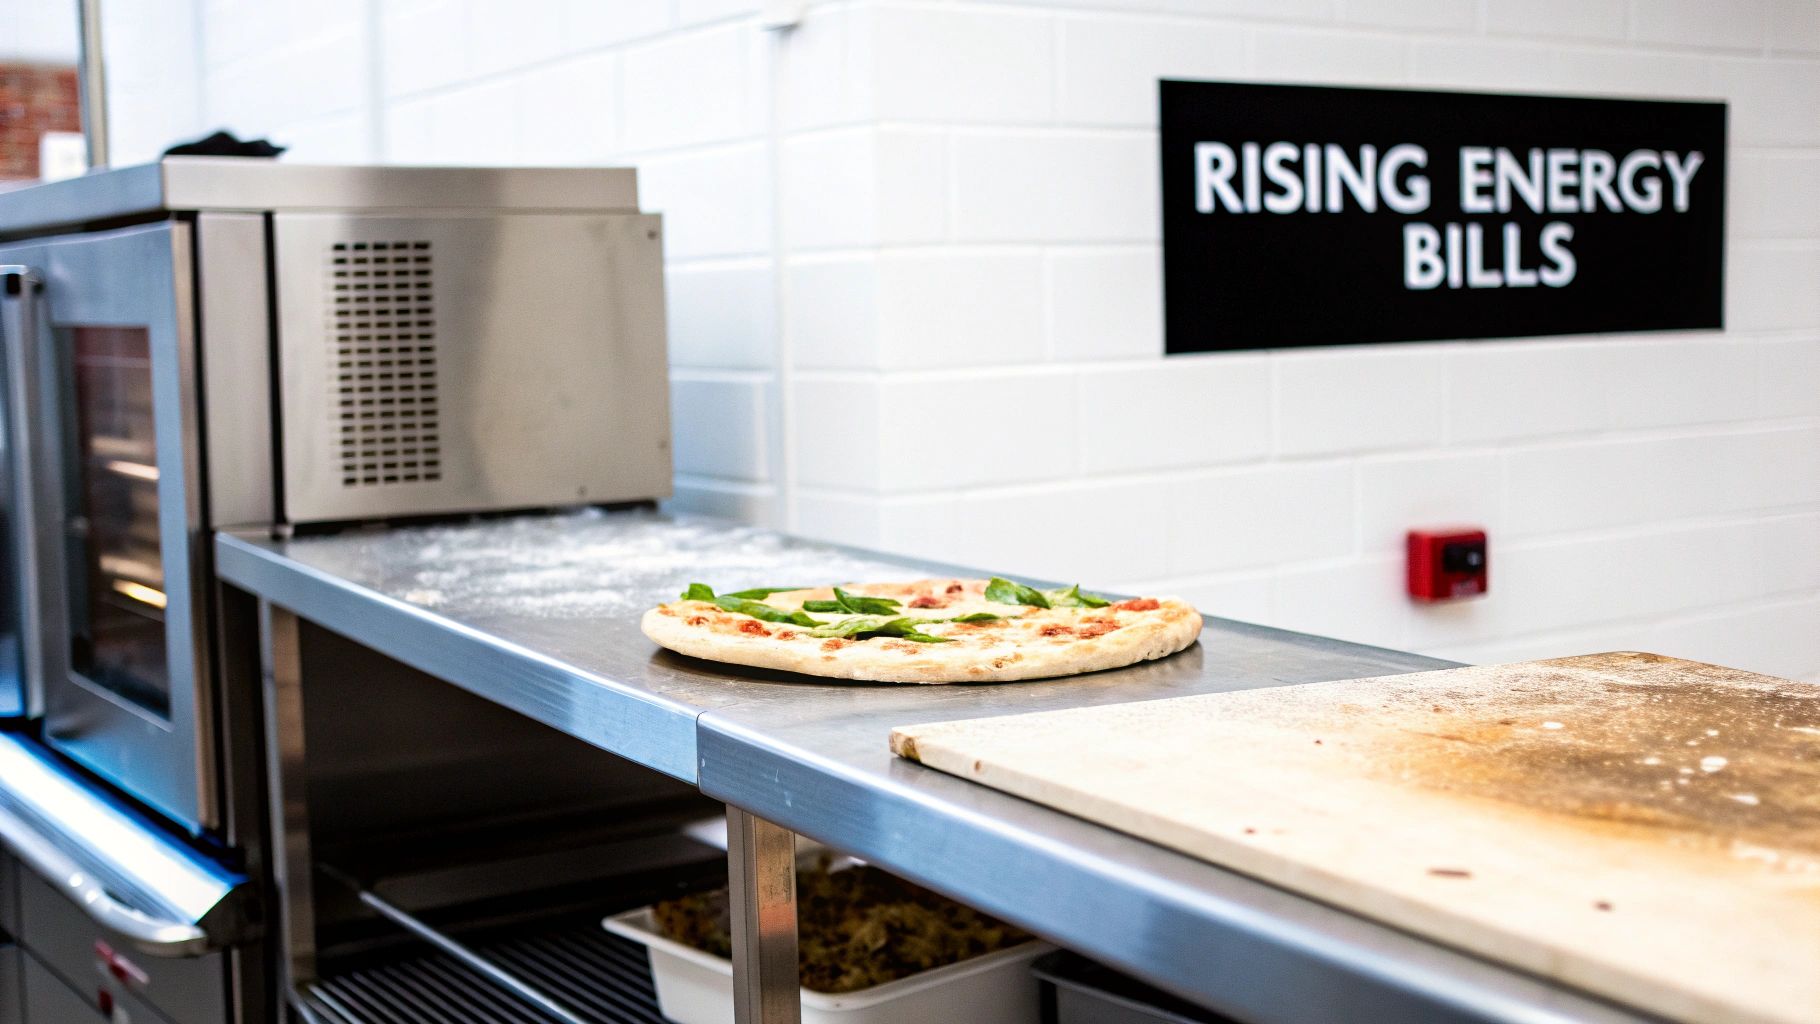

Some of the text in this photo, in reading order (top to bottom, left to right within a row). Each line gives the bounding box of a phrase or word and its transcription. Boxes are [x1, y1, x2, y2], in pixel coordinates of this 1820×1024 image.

[1194, 142, 1704, 214] RISING ENERGY
[1403, 223, 1576, 289] BILLS
